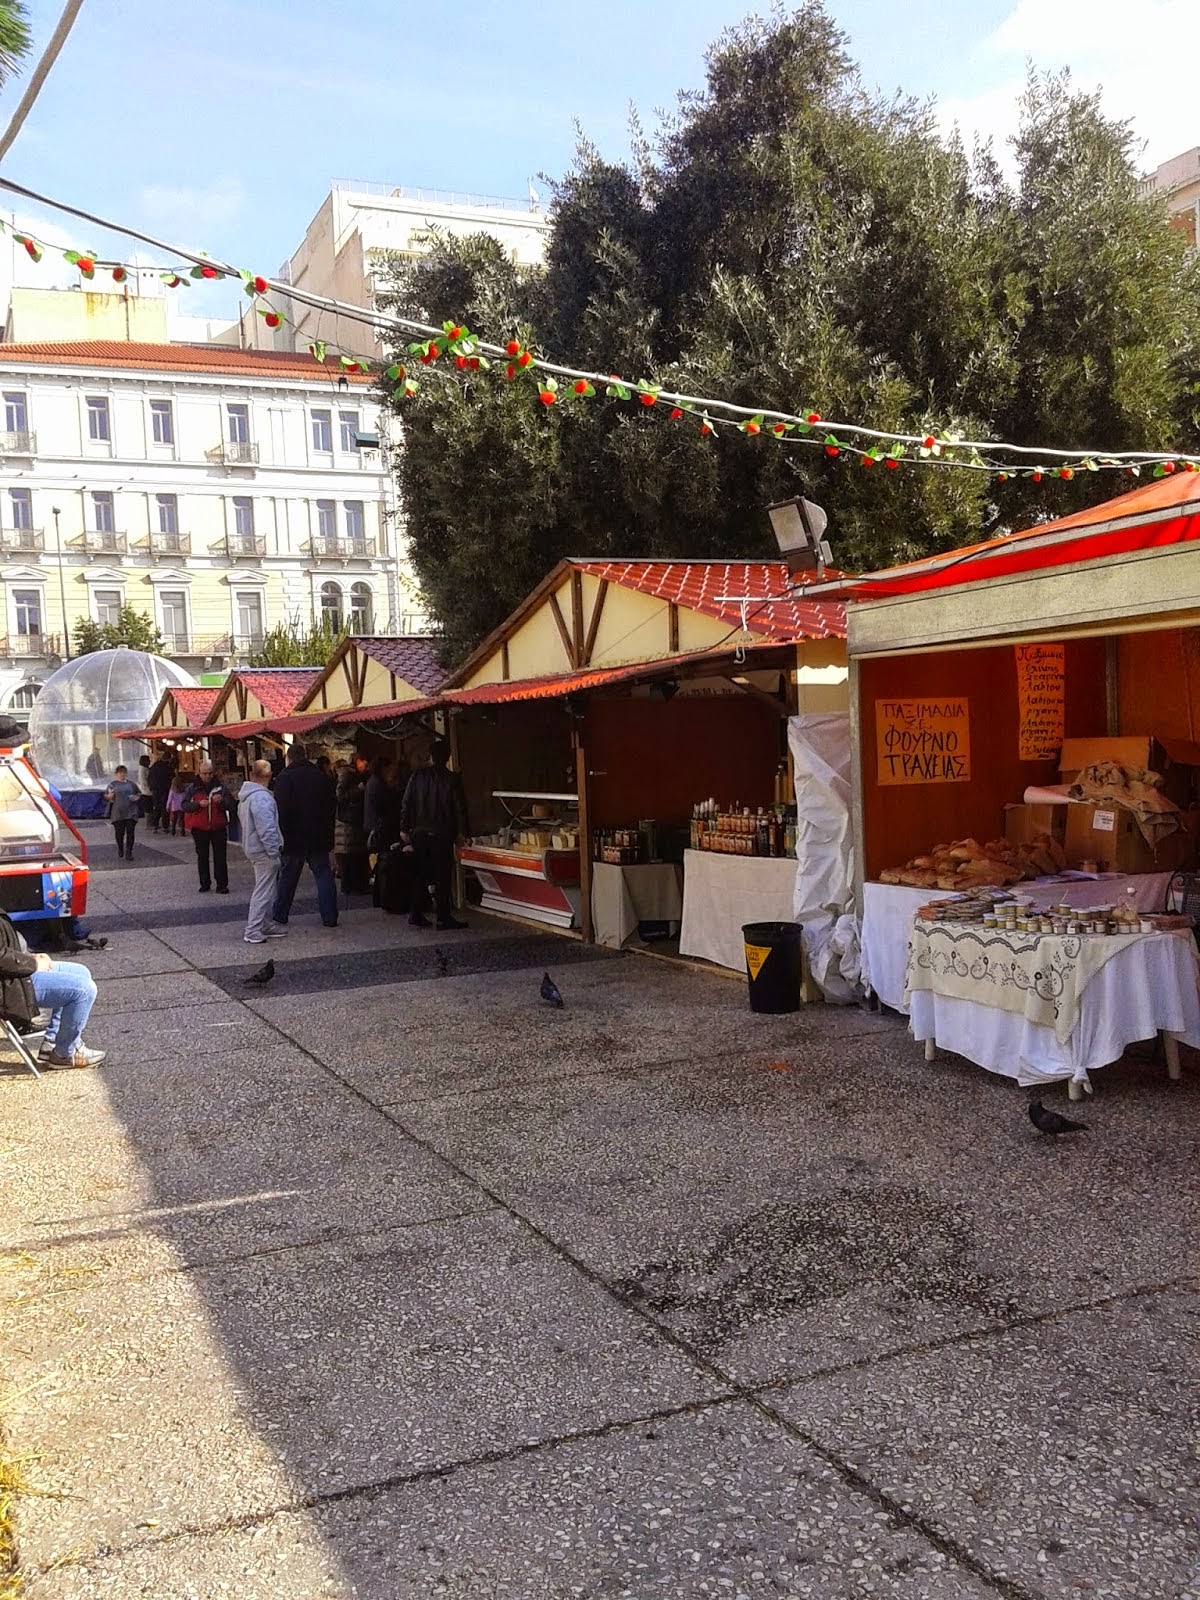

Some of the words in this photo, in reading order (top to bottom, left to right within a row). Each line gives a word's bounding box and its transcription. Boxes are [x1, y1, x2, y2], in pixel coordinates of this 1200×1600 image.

[882, 704, 965, 718] ΠΑΞΙΜΑΔΙΑ
[884, 725, 958, 753] ΦΟΥΡΝΟ
[884, 753, 969, 779] ΤΡΑΧΕΙΑΣ
